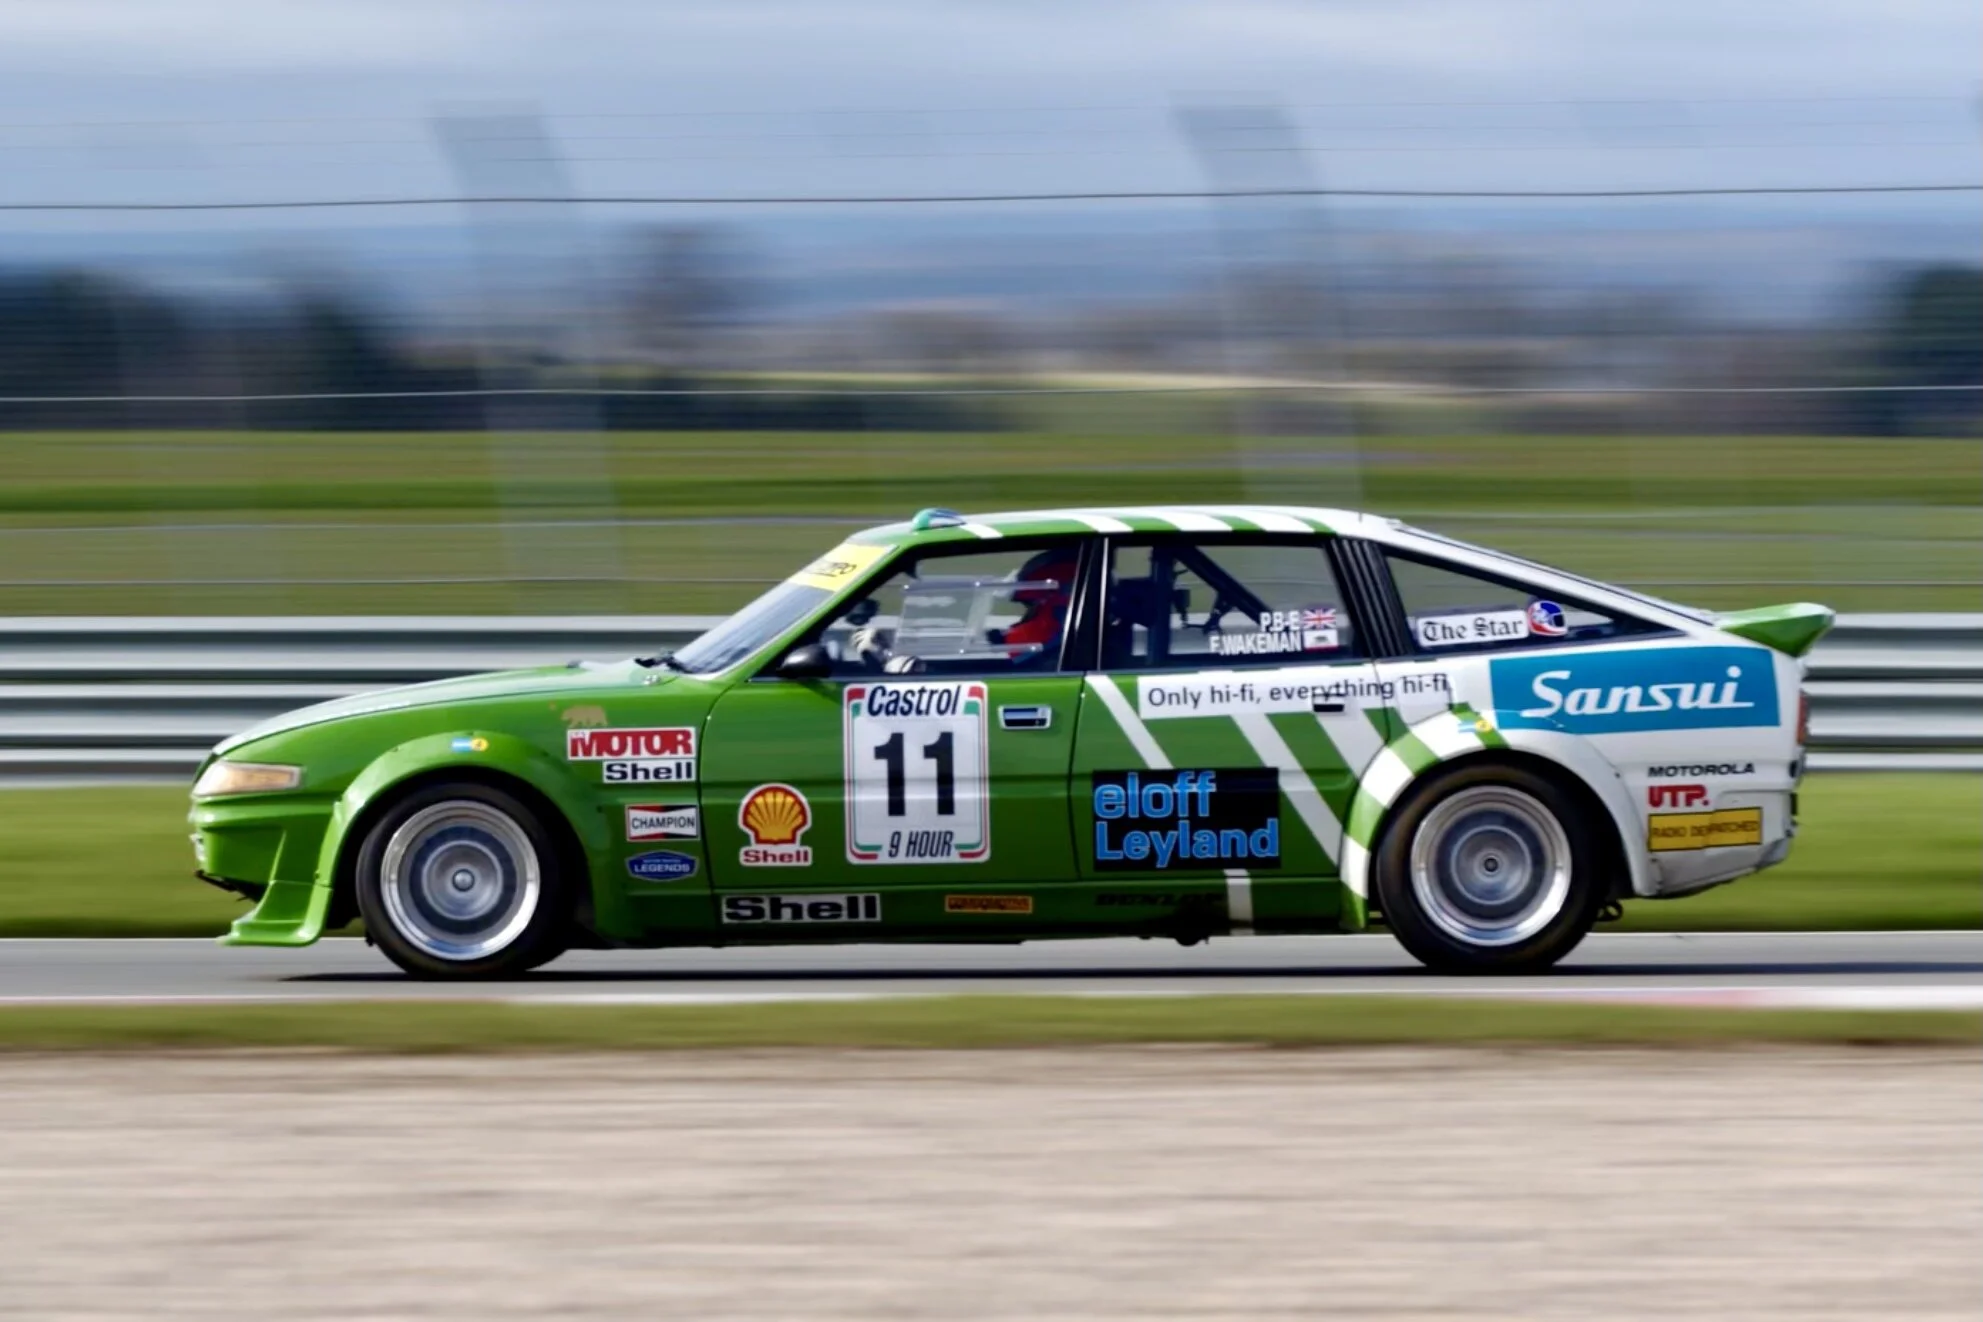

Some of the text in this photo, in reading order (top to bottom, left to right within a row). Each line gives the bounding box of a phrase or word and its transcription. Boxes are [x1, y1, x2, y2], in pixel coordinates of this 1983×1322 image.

[1422, 617, 1524, 642] The Star
[867, 684, 961, 717] Castrol
[1148, 686, 1200, 709] Only
[1210, 683, 1261, 704] hi-fi,
[1269, 679, 1395, 703] everything
[1520, 665, 1755, 718] Sansui
[570, 729, 693, 758] MOTOR
[605, 762, 692, 782] Shell
[874, 731, 955, 817] 11
[1648, 763, 1755, 777] MOTOROLA
[1094, 771, 1216, 819] eloff
[631, 815, 696, 830] CHAMPION
[743, 849, 809, 864] Shell
[888, 830, 954, 858] 9 HOUR
[1096, 818, 1279, 868] Leyland
[634, 863, 691, 873] LEGENDS
[725, 895, 877, 920] Shell
